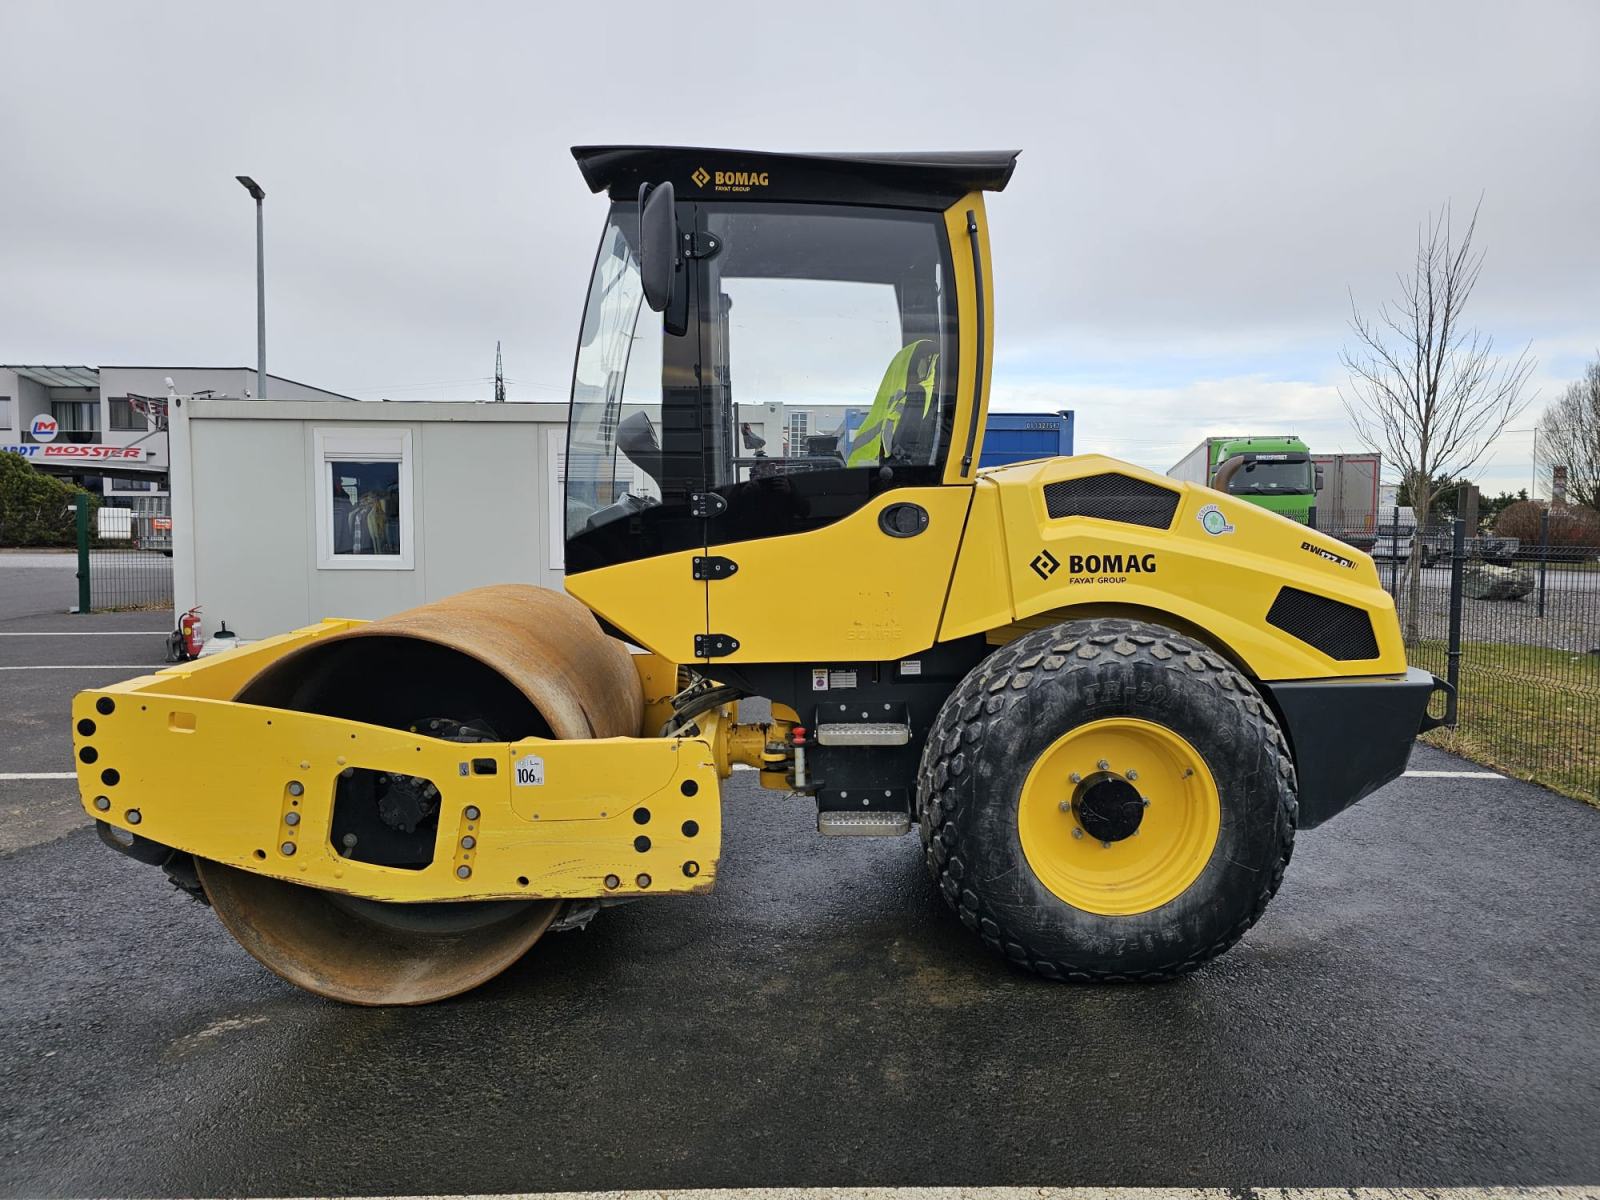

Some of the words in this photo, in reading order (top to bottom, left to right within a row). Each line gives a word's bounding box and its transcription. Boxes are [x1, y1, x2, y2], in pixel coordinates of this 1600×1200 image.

[715, 171, 769, 186] BOMAG
[1069, 554, 1156, 574] BOMAG
[1097, 576, 1127, 584] GROUP
[517, 768, 536, 784] 106
